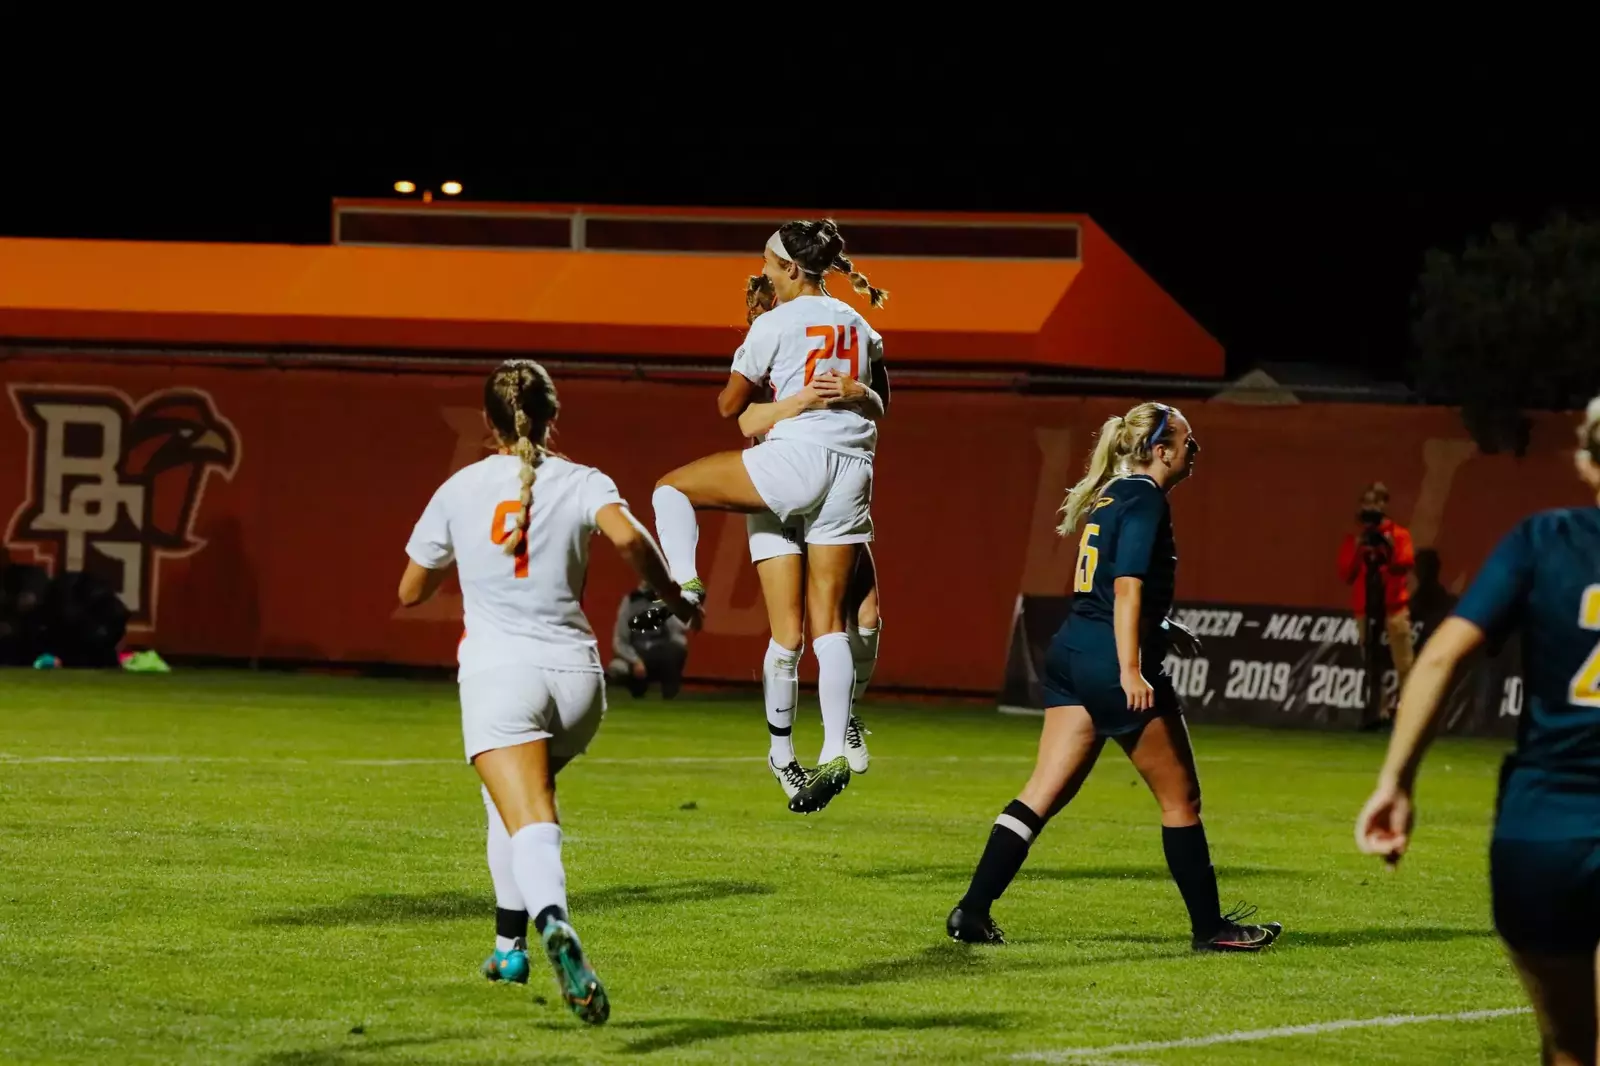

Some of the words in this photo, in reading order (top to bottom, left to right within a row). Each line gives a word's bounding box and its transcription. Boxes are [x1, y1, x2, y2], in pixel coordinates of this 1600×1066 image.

[804, 324, 858, 387] 24
[491, 500, 530, 578] 9
[1261, 613, 1313, 641] MAC
[1161, 653, 1216, 706] 018,
[1224, 659, 1296, 712] 2019,
